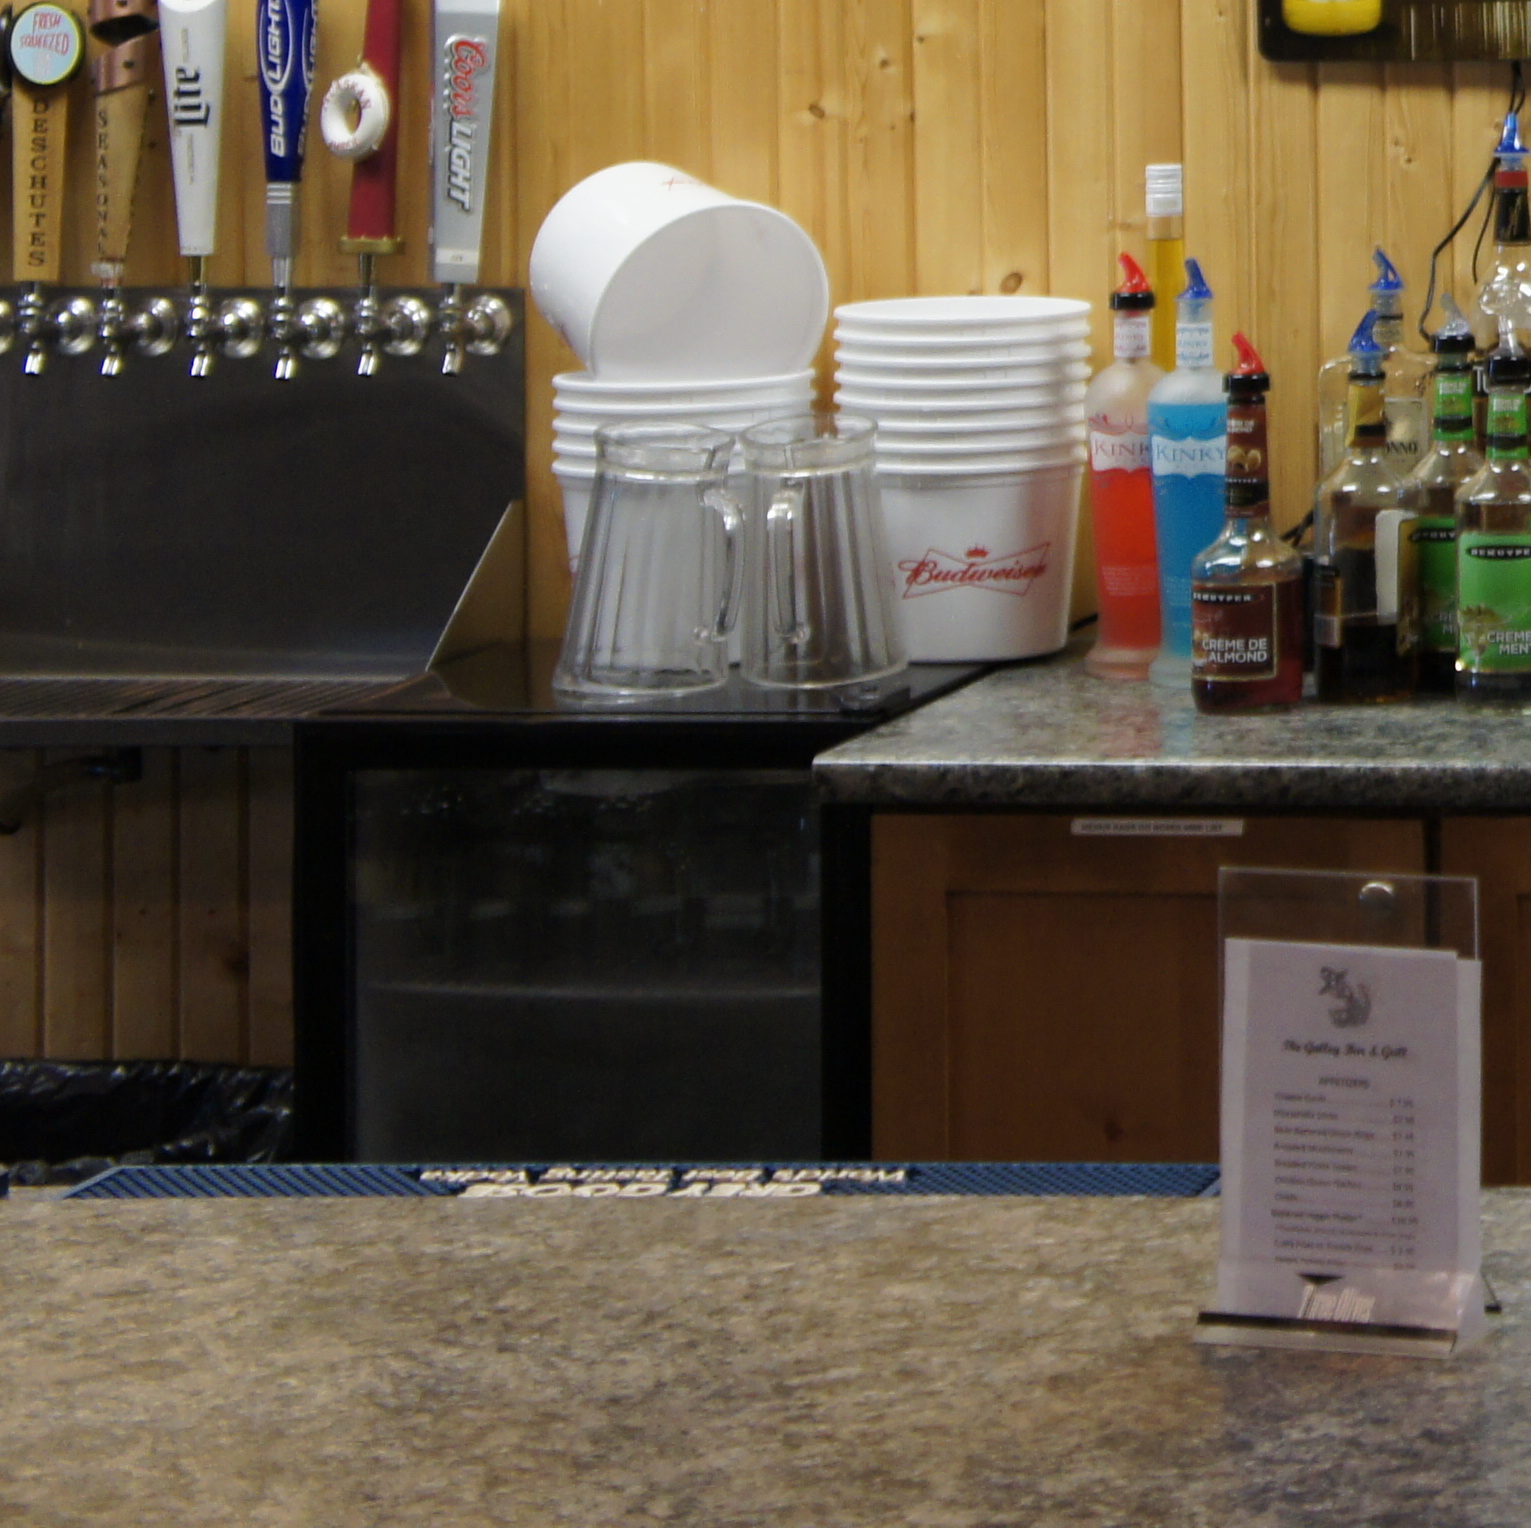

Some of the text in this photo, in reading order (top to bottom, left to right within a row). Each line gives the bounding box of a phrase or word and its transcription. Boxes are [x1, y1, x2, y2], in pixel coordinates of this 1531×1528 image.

[33, 12, 62, 31] FRESH
[20, 33, 70, 57] SQUEEZED
[174, 67, 210, 128] Lite
[270, 93, 285, 158] BUD
[449, 39, 487, 214] Coors LIGHT
[28, 100, 48, 267] DESCHUTES
[1156, 443, 1226, 463] KINKY
[898, 559, 1047, 586] Budweiser
[1209, 650, 1268, 663] ALMOND
[1249, 638, 1268, 650] DE
